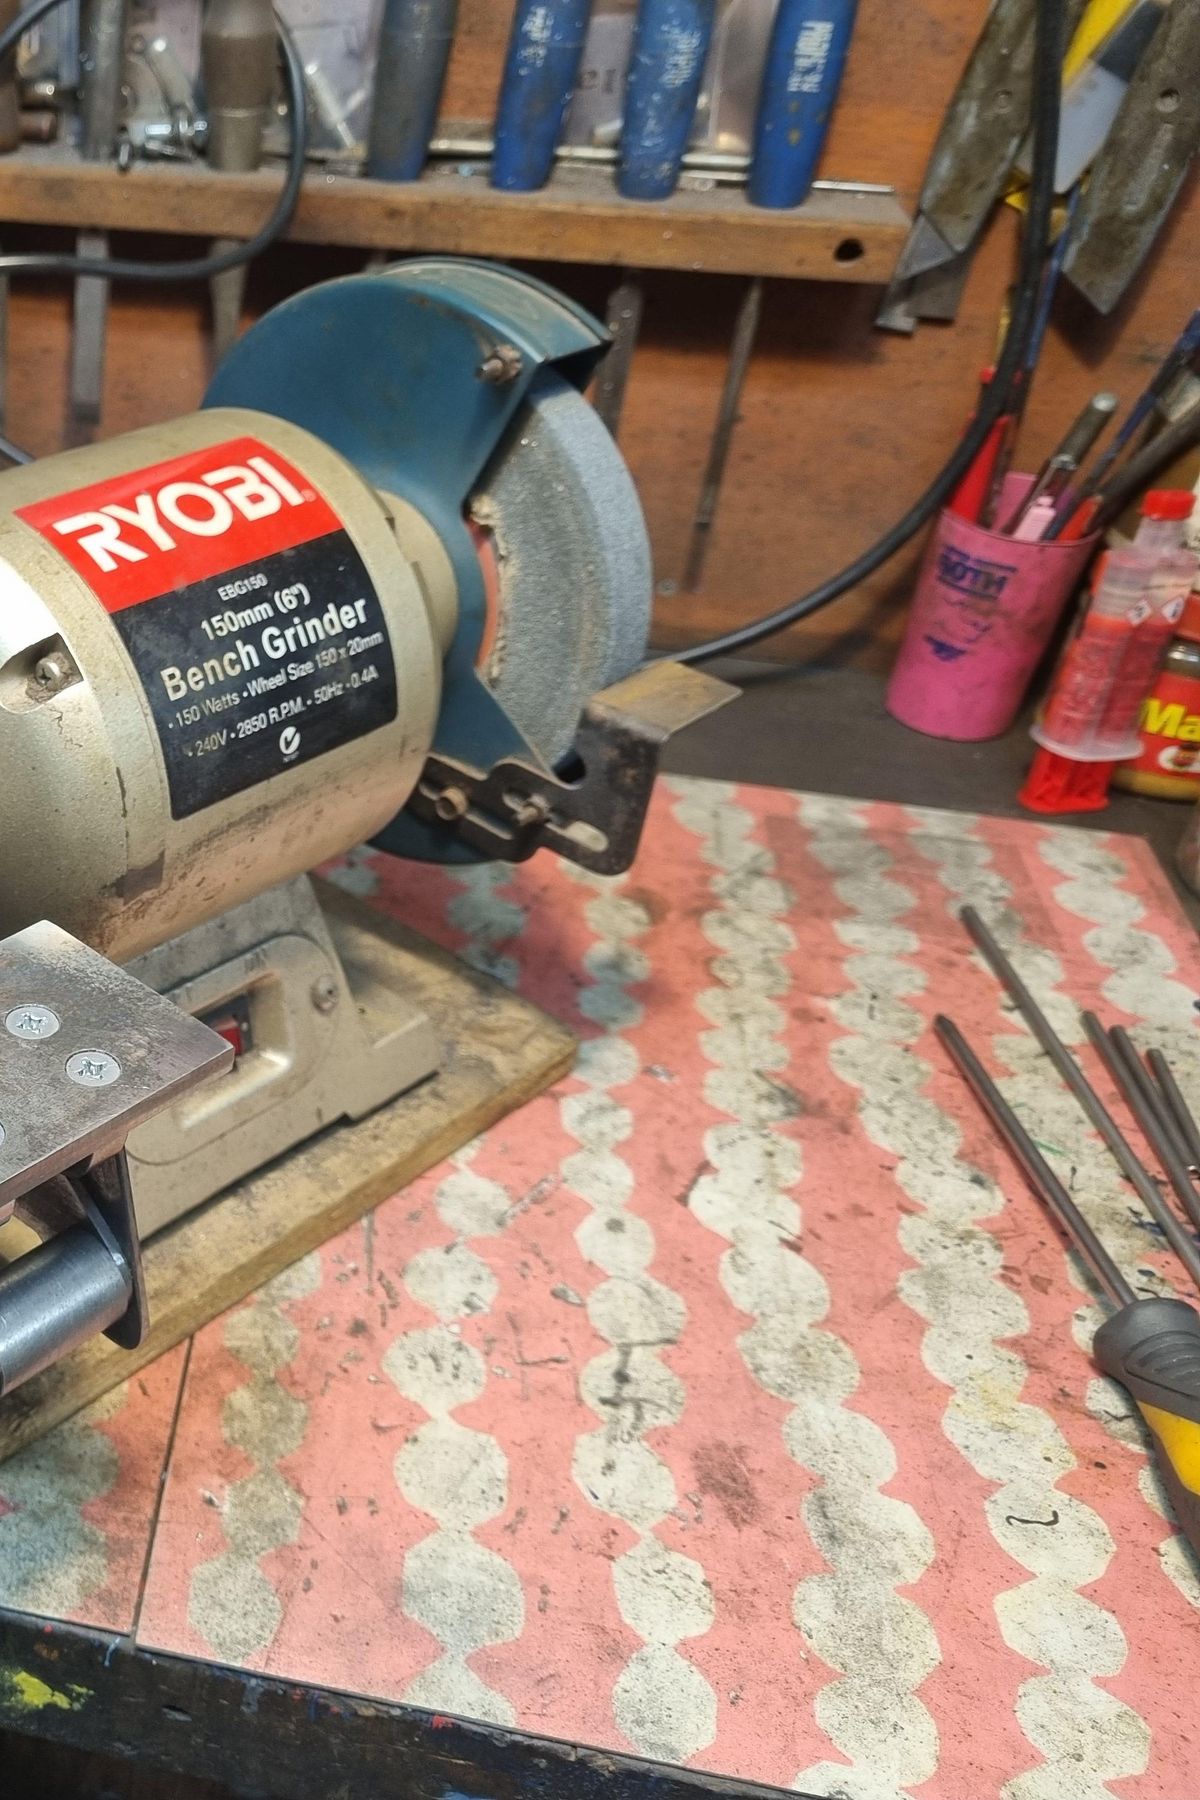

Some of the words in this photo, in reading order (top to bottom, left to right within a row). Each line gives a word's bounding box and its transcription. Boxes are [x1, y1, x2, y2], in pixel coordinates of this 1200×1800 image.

[51, 455, 306, 573] RYOBI
[201, 602, 275, 640] 150mm
[273, 582, 311, 614] (6")
[217, 573, 268, 601] EBG150
[160, 639, 261, 701] Bench
[261, 598, 367, 660] Grinder
[175, 705, 201, 727] 150
[201, 692, 241, 716] Watts
[246, 668, 288, 697] Wheel
[287, 660, 315, 681] Size
[315, 647, 338, 668] 150
[338, 647, 349, 659] x
[347, 631, 384, 656] 20mm
[195, 728, 227, 756] 240V
[236, 713, 268, 738] 2850
[313, 681, 345, 705] 50Hz
[350, 664, 380, 689] 0.4A
